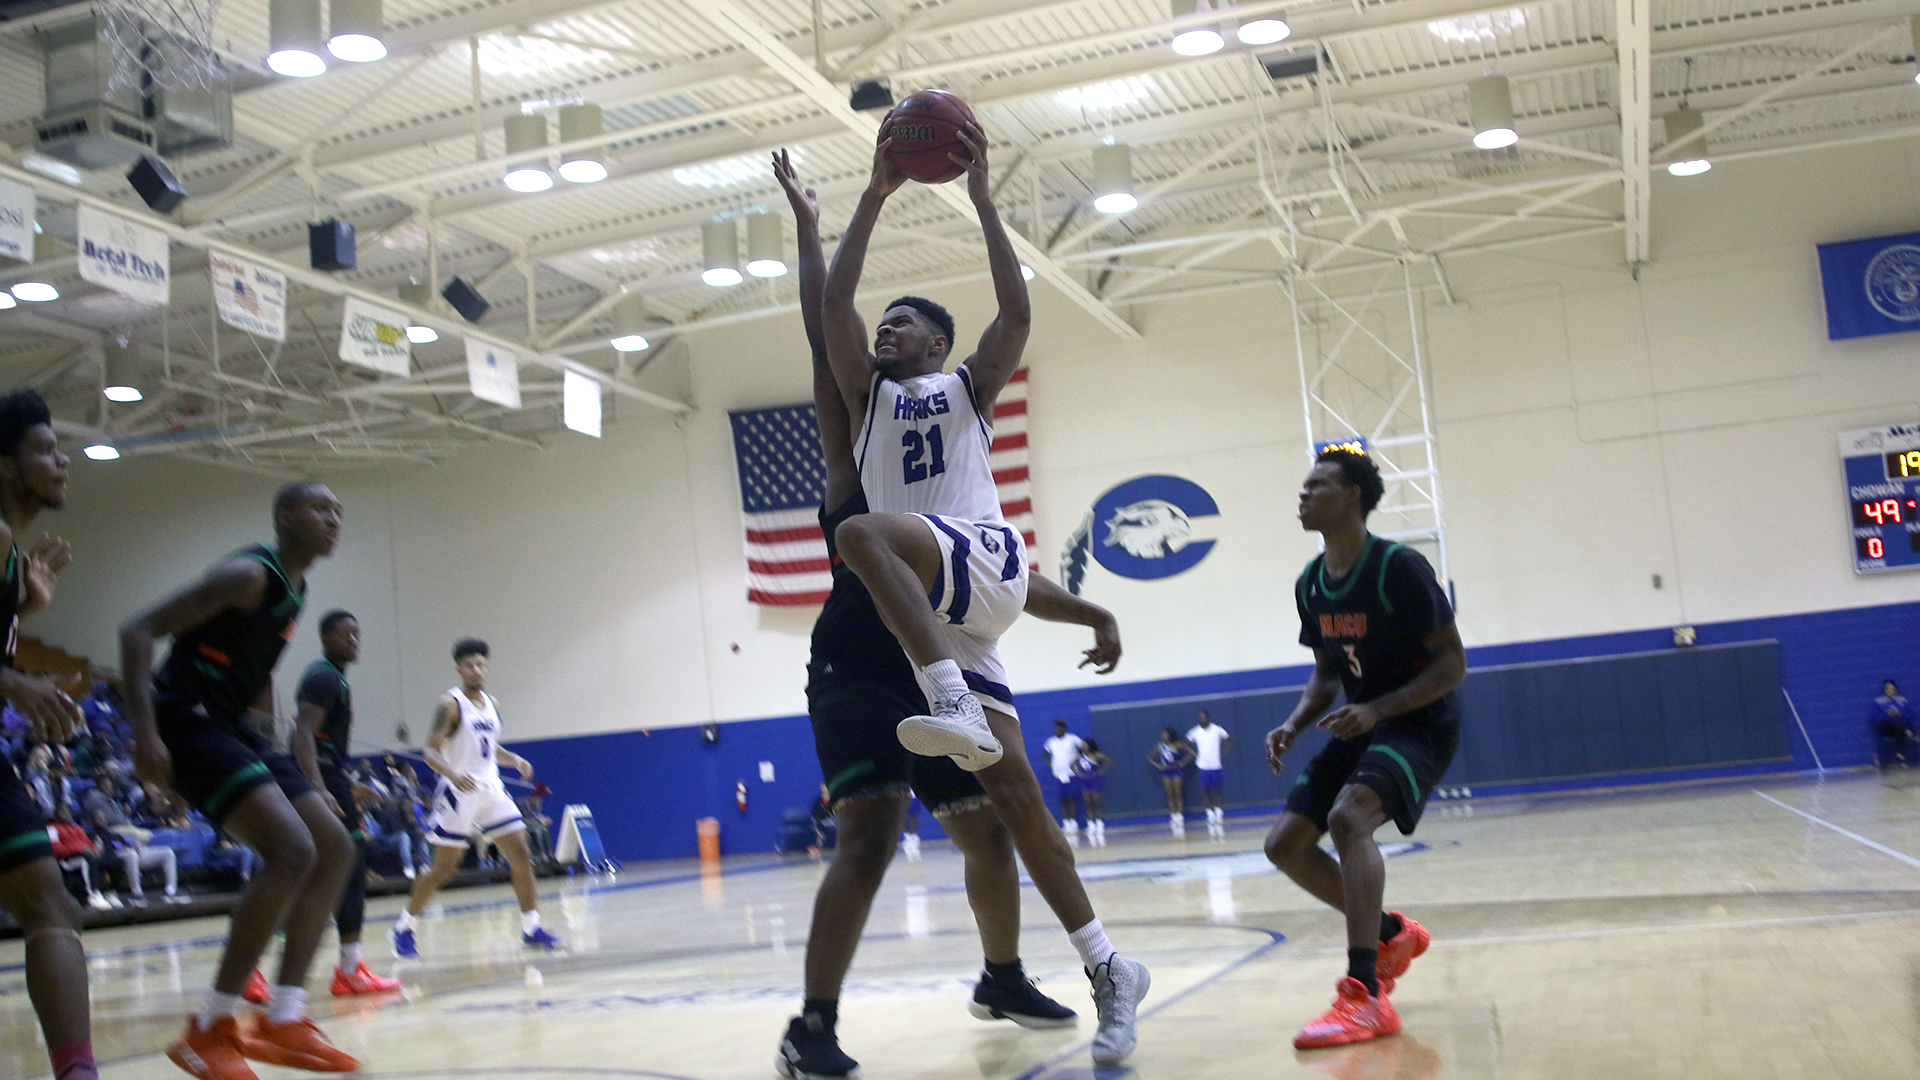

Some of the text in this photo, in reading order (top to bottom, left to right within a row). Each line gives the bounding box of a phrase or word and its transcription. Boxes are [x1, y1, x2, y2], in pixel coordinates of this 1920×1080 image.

[889, 123, 936, 142] Wilso
[902, 423, 945, 485] 21
[1863, 498, 1902, 526] 49
[1866, 536, 1884, 559] 0
[1341, 643, 1363, 678] 3
